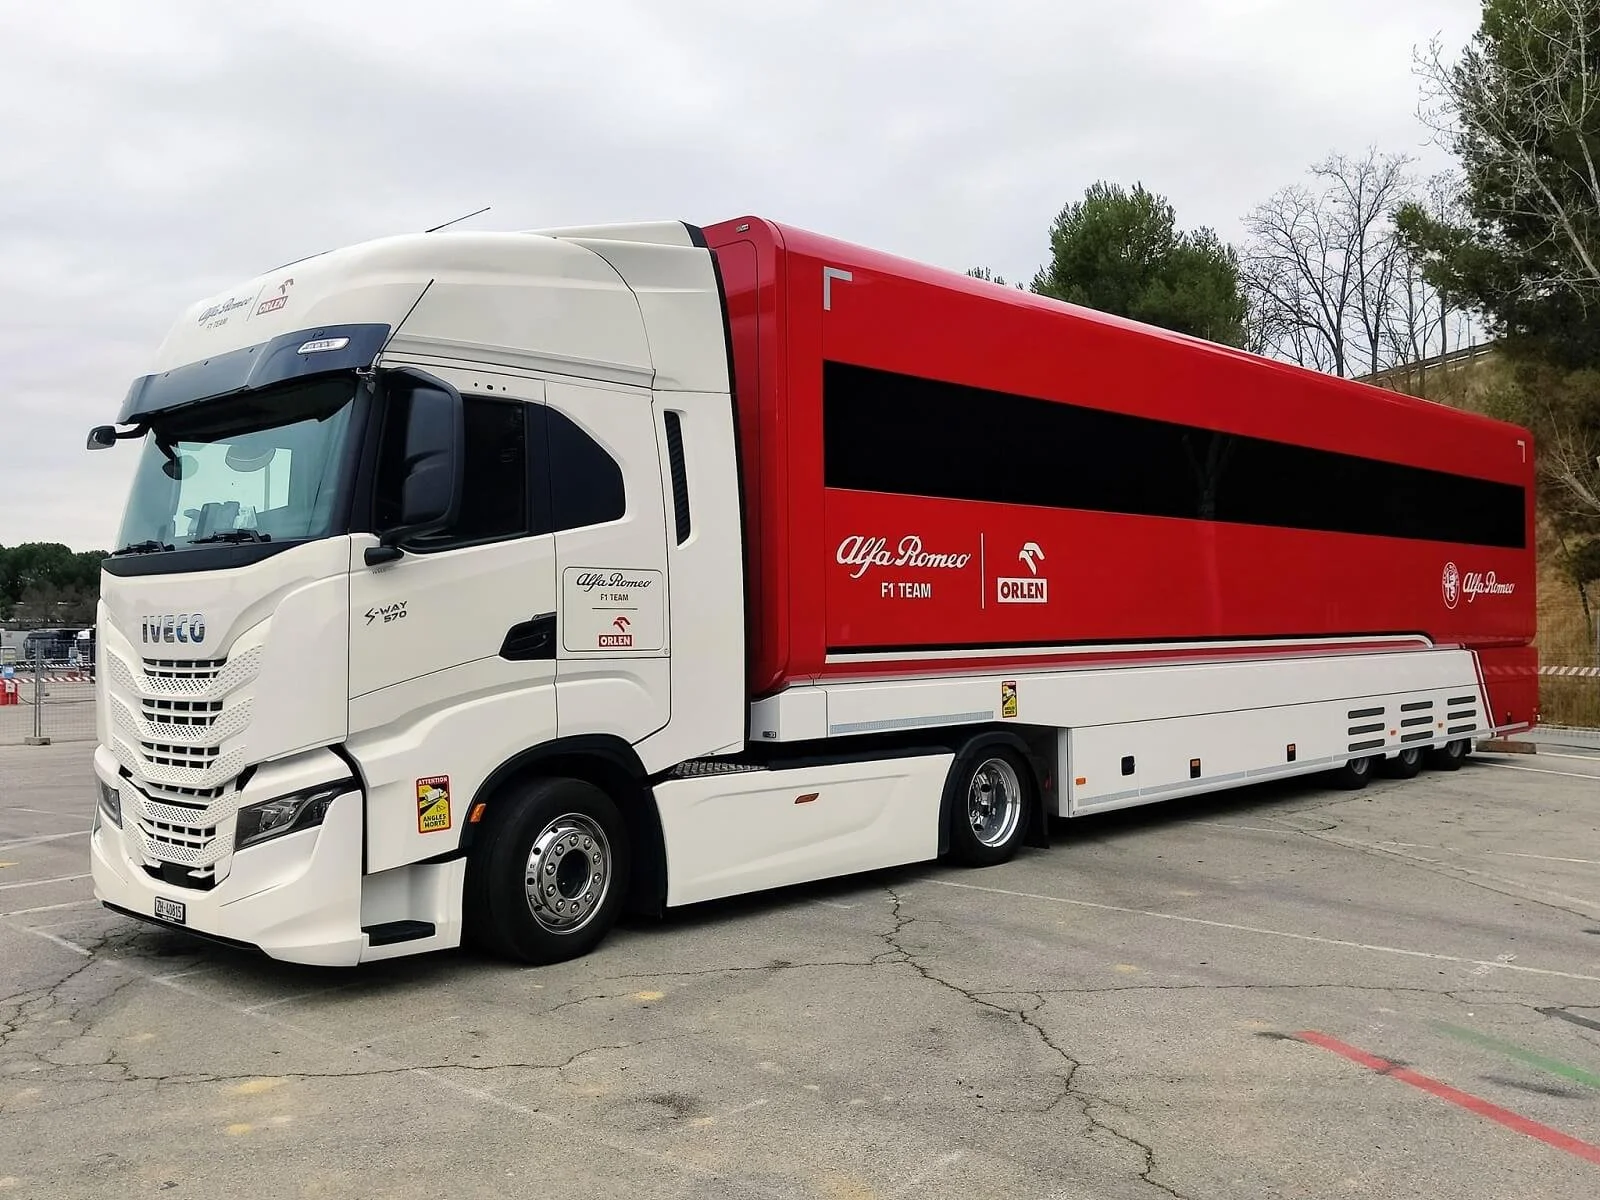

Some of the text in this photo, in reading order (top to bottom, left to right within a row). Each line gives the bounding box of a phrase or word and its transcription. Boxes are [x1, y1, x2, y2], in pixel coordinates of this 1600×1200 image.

[258, 297, 287, 314] ORLEN
[836, 535, 971, 578] Alfa Romeo
[576, 572, 652, 592] Alfa Romeo
[881, 582, 931, 598] F1 TEAM
[1000, 581, 1044, 599] ORLEN
[1462, 572, 1486, 603] Alfa
[1485, 571, 1515, 594] Romeo
[600, 593, 629, 601] F1 TEAM
[383, 610, 408, 623] 570
[142, 613, 205, 643] IVECO
[600, 636, 631, 646] ORLEN
[418, 776, 448, 785] ATTENTION
[423, 813, 447, 822] ANGLES
[424, 820, 446, 828] MORTS
